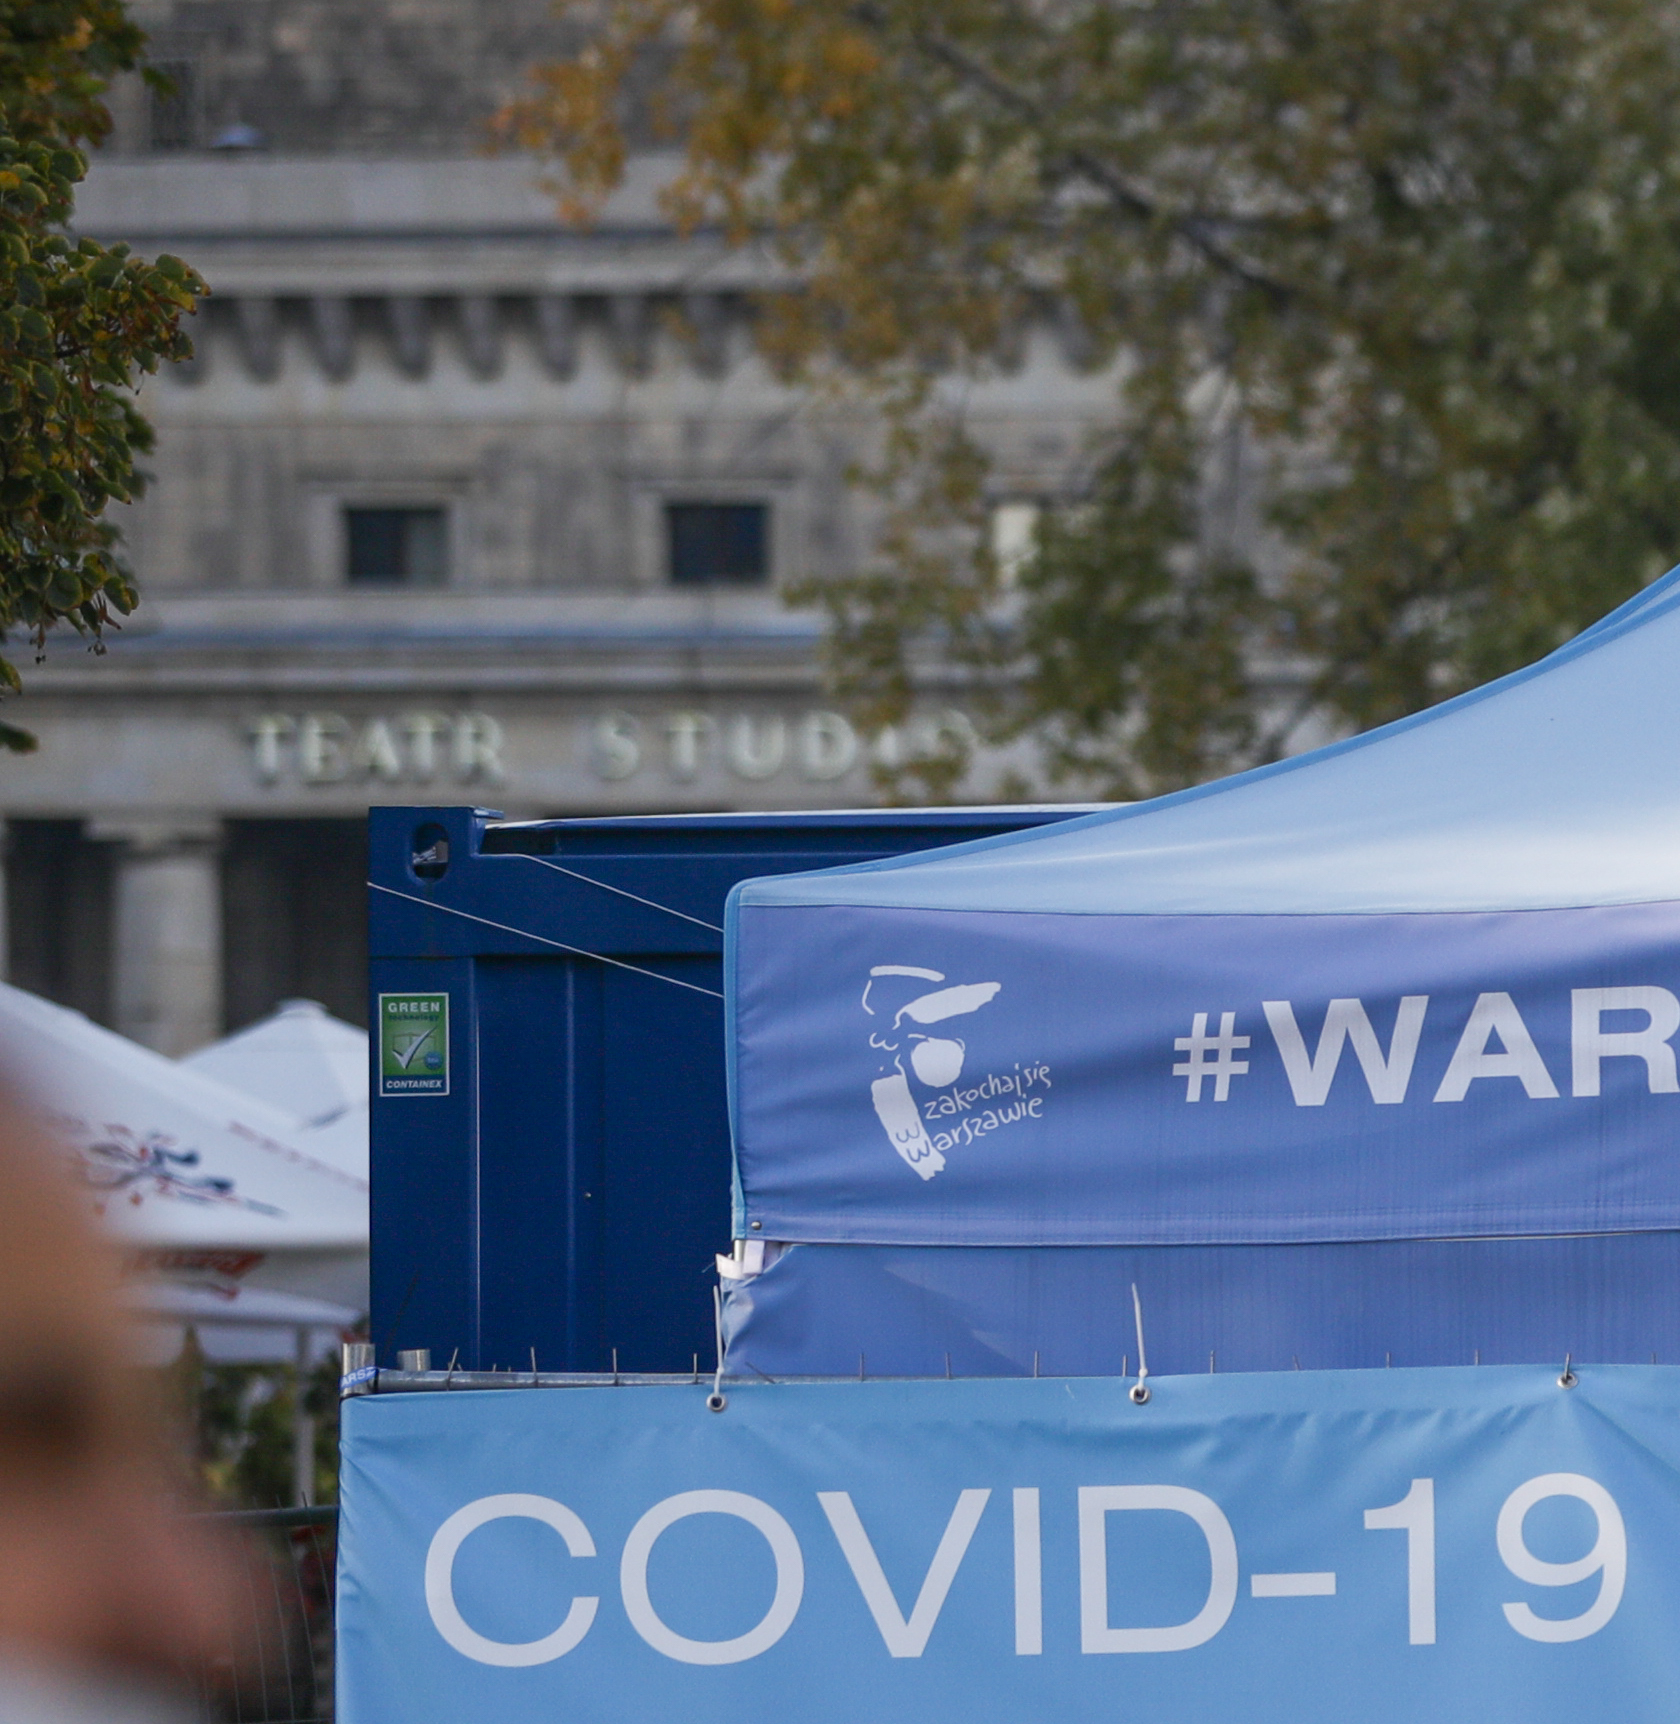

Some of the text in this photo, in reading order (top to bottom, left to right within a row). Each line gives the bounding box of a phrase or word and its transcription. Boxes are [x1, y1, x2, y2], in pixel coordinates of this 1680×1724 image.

[249, 711, 502, 784] TEATR
[388, 1002, 440, 1013] GREEN
[386, 1080, 442, 1088] CONTAINEX
[925, 1061, 1052, 1119] zakochaj się
[425, 1472, 1628, 1667] COVID-19
